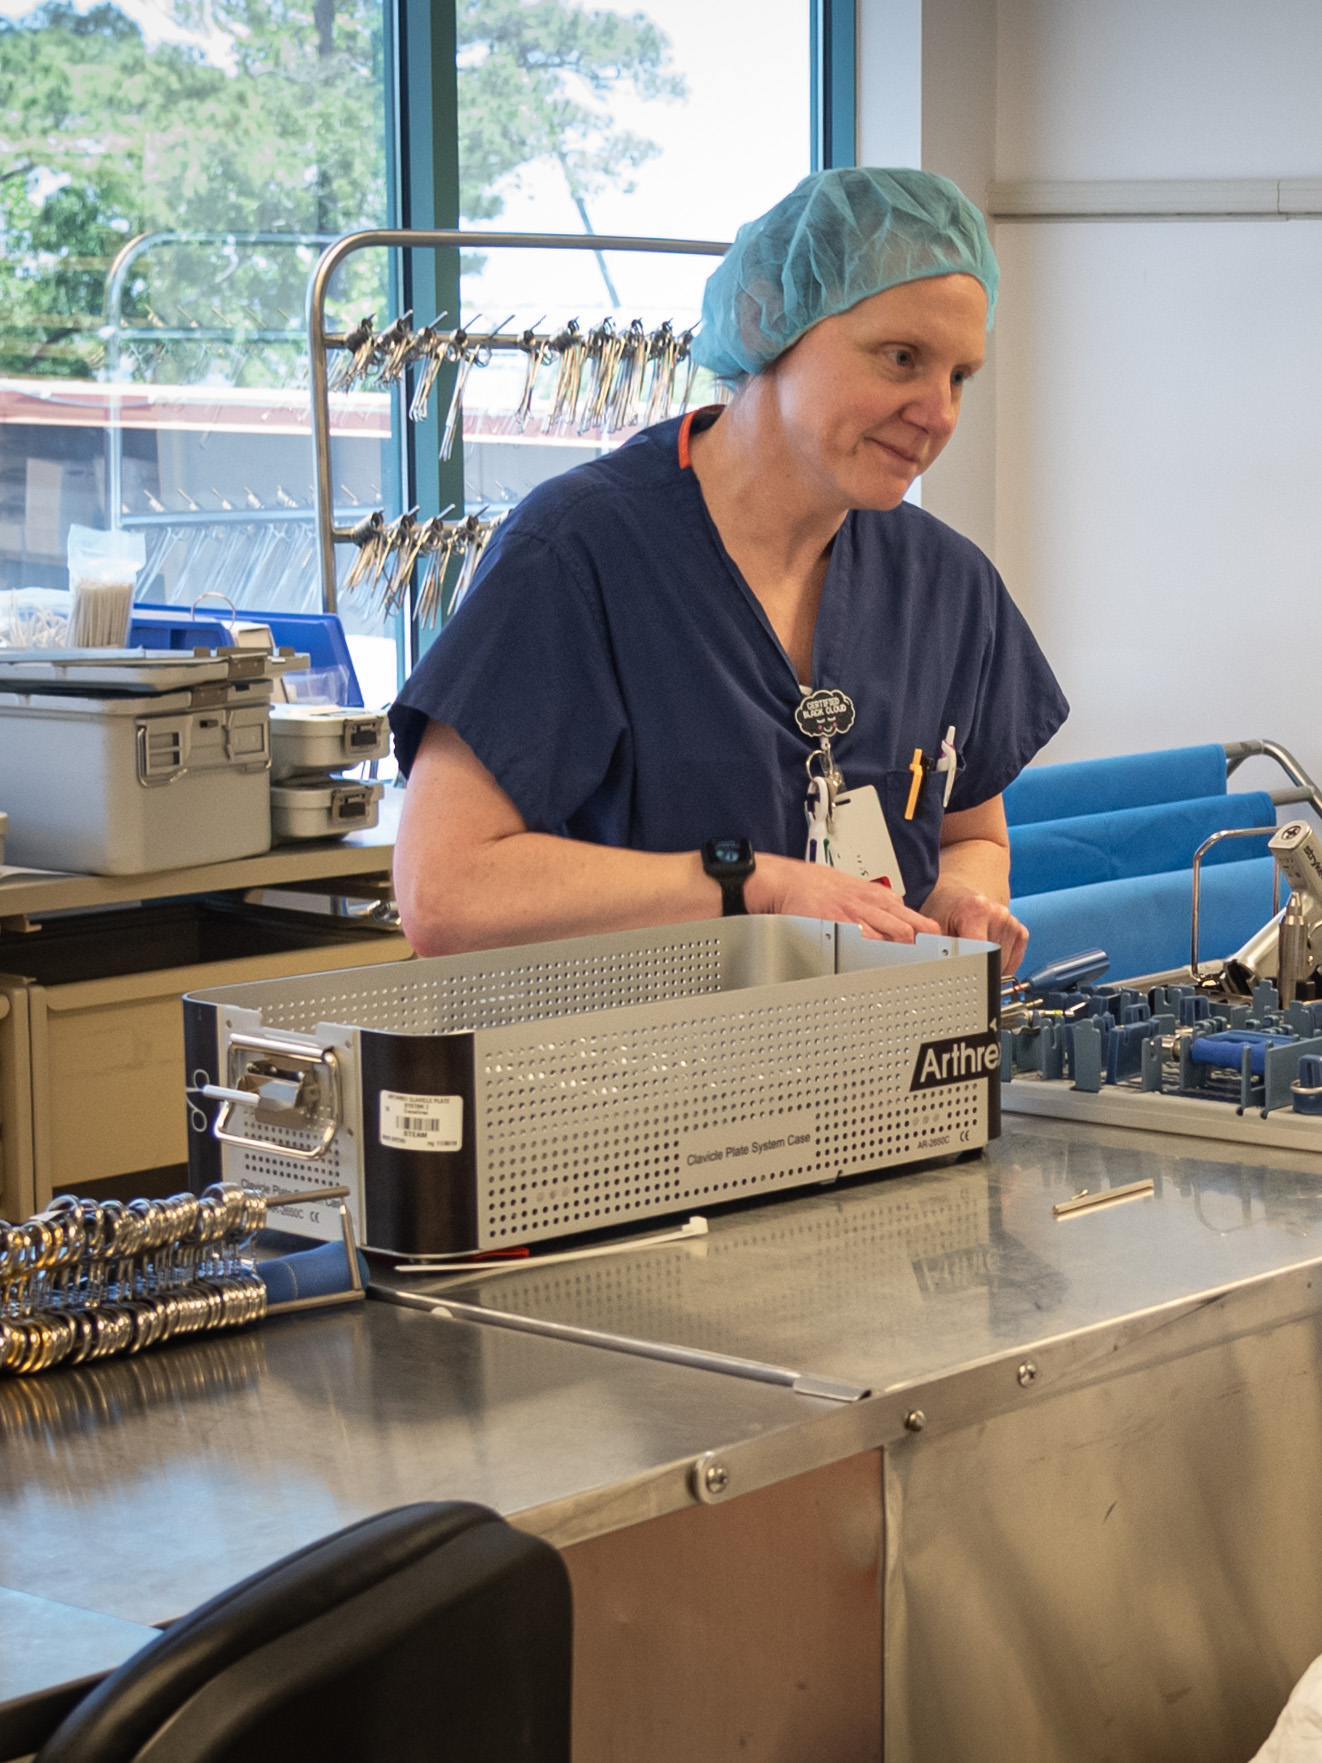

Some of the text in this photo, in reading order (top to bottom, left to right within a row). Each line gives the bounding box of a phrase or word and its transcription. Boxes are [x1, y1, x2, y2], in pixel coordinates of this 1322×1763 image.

[807, 697, 840, 710] CERTIFIED
[803, 704, 847, 719] BLACK CLOUD
[920, 1041, 1001, 1083] Arthre
[404, 1130, 427, 1138] STEAM
[687, 1133, 811, 1166] Clavicle Plate System Case
